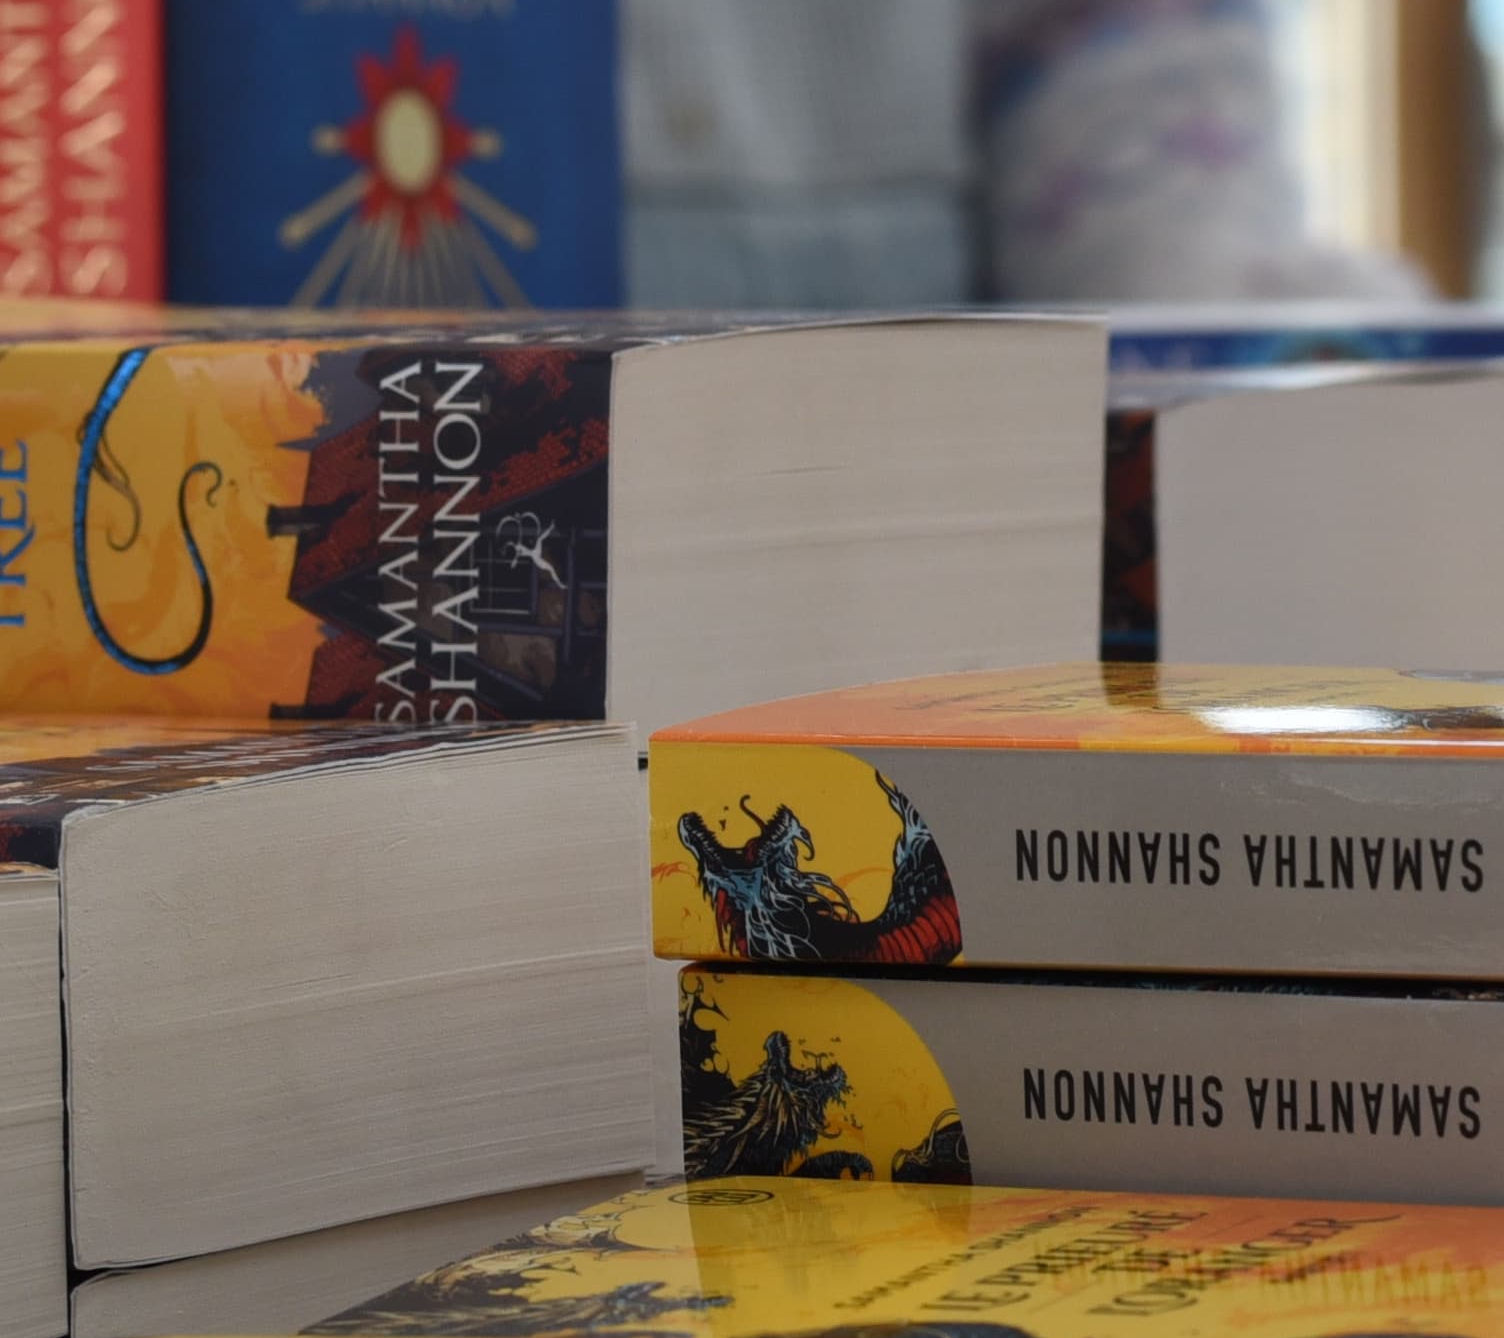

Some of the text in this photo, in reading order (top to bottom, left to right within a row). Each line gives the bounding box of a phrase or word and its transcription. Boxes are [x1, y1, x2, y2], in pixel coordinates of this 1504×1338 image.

[375, 359, 423, 723] SAMANTHA
[429, 359, 485, 724] SHANNON
[1014, 827, 1485, 894] SAMANTHA SHANNON
[1023, 1066, 1481, 1141] SAMANTHA SHANNON
